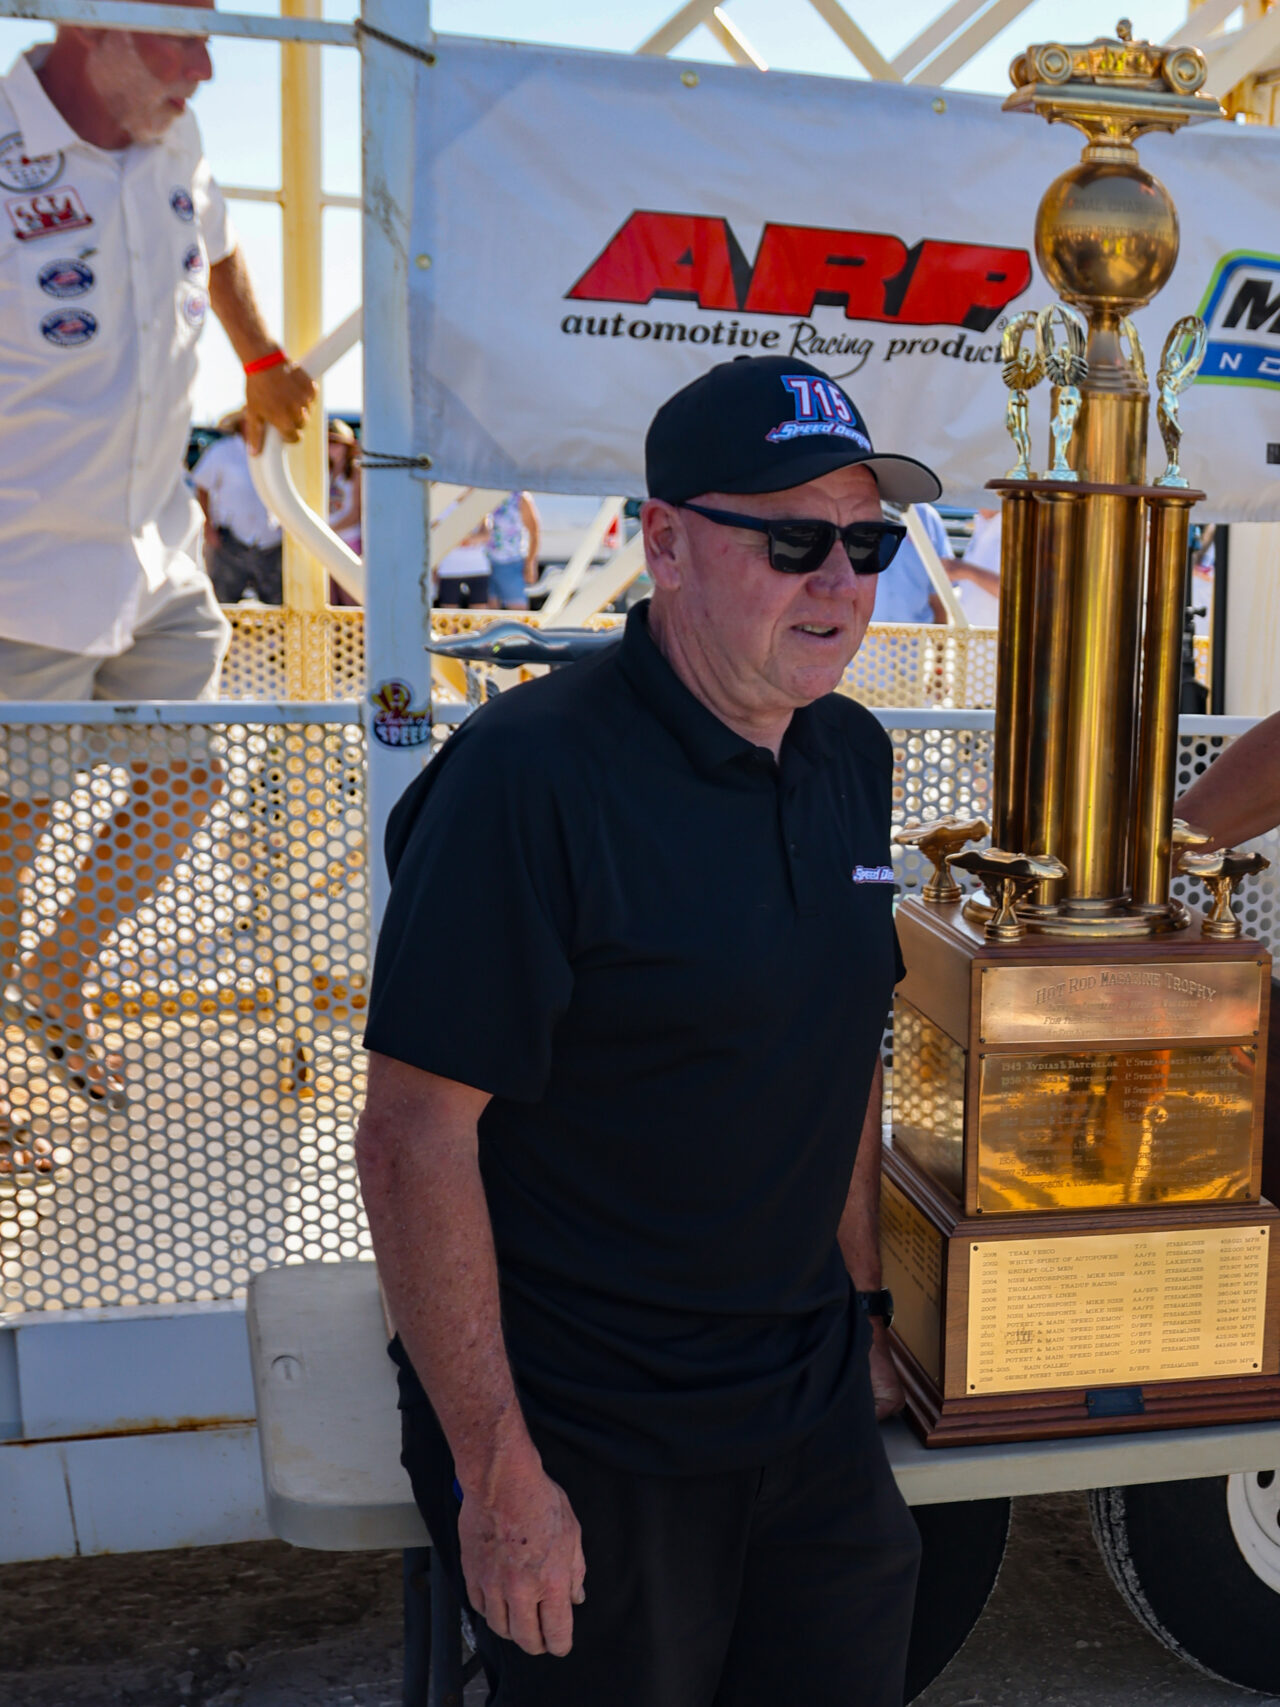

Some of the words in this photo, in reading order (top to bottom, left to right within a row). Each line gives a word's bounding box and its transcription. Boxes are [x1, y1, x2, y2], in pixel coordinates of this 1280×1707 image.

[564, 208, 1033, 333] ARP
[560, 312, 780, 350] automotive
[788, 321, 875, 380] Racing
[883, 332, 1004, 365] product
[785, 377, 854, 425] 715
[1035, 983, 1066, 1005] HOT
[1068, 976, 1097, 993] ROD
[1100, 971, 1161, 988] MAGAZINE
[1165, 973, 1217, 1002] TROPHY
